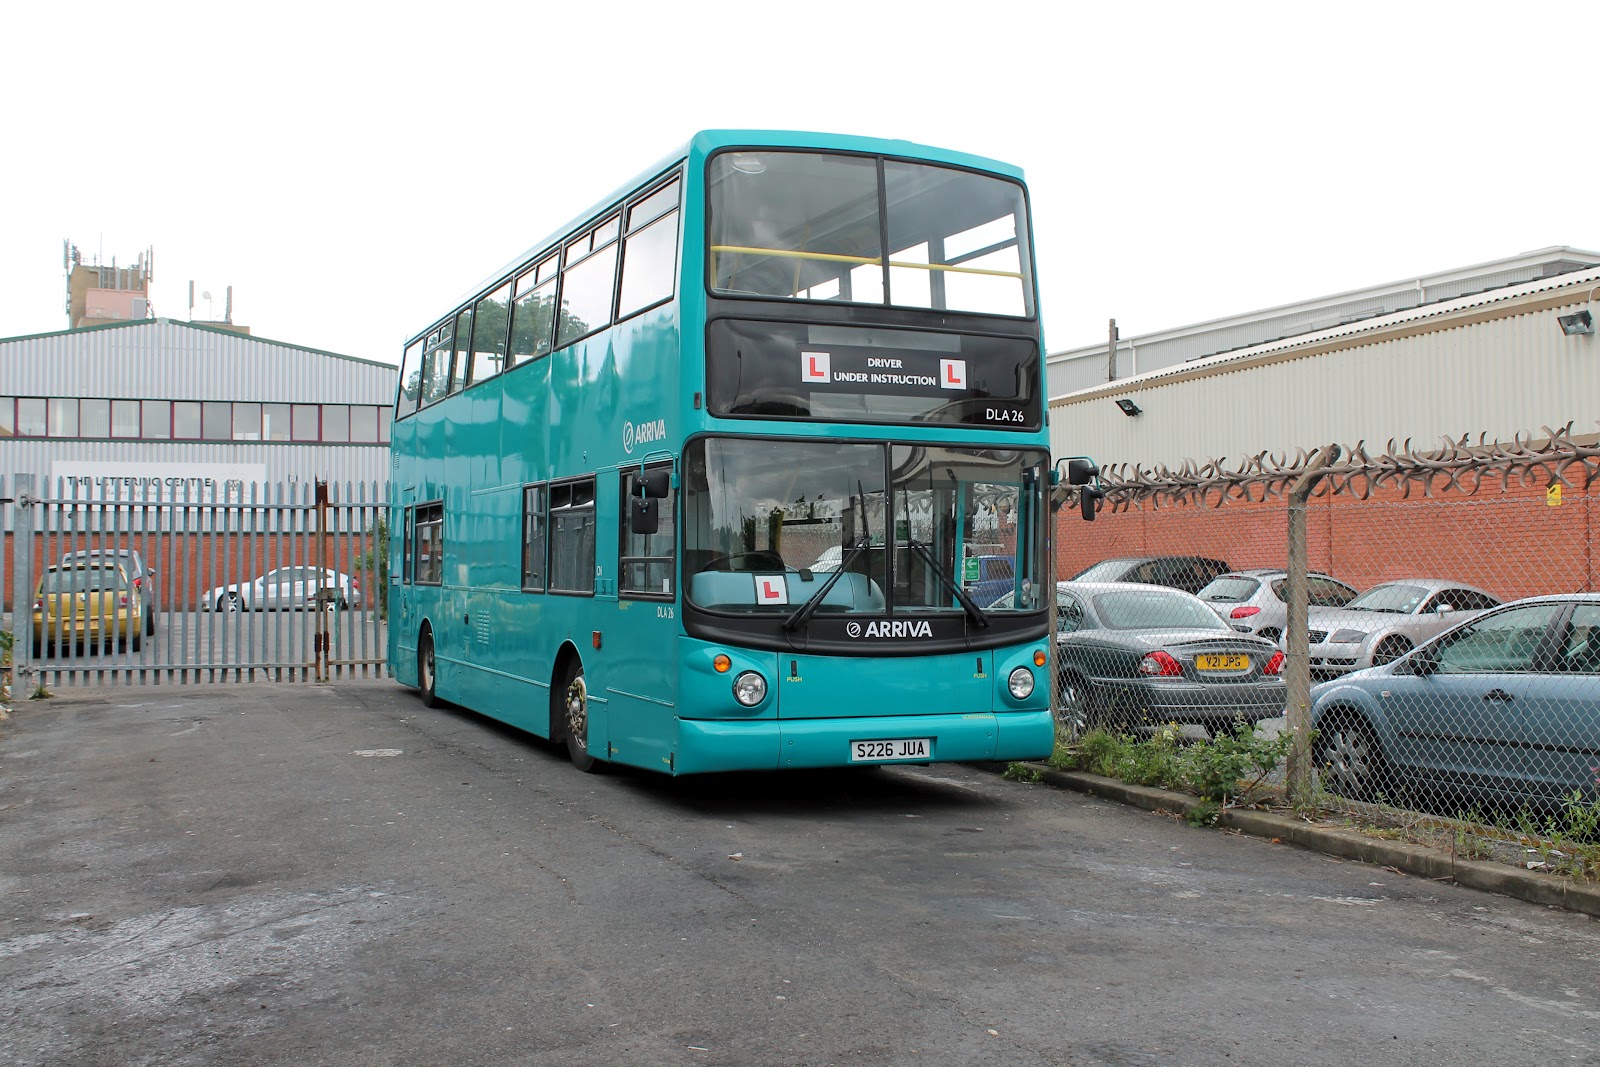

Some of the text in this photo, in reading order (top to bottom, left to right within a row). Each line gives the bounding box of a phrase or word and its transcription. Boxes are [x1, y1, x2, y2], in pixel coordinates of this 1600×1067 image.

[809, 356, 825, 377] L
[867, 357, 903, 369] DRIVER
[833, 372, 936, 386] UNDER INSTRUCTION
[947, 363, 961, 384] L
[986, 408, 1025, 423] DLA 26
[634, 419, 666, 445] ARRIVA
[165, 477, 212, 487] CENTE
[763, 581, 780, 599] L
[657, 606, 675, 619] DLA 26
[864, 621, 933, 638] ARRIVA
[857, 741, 925, 758] S226 JUA
